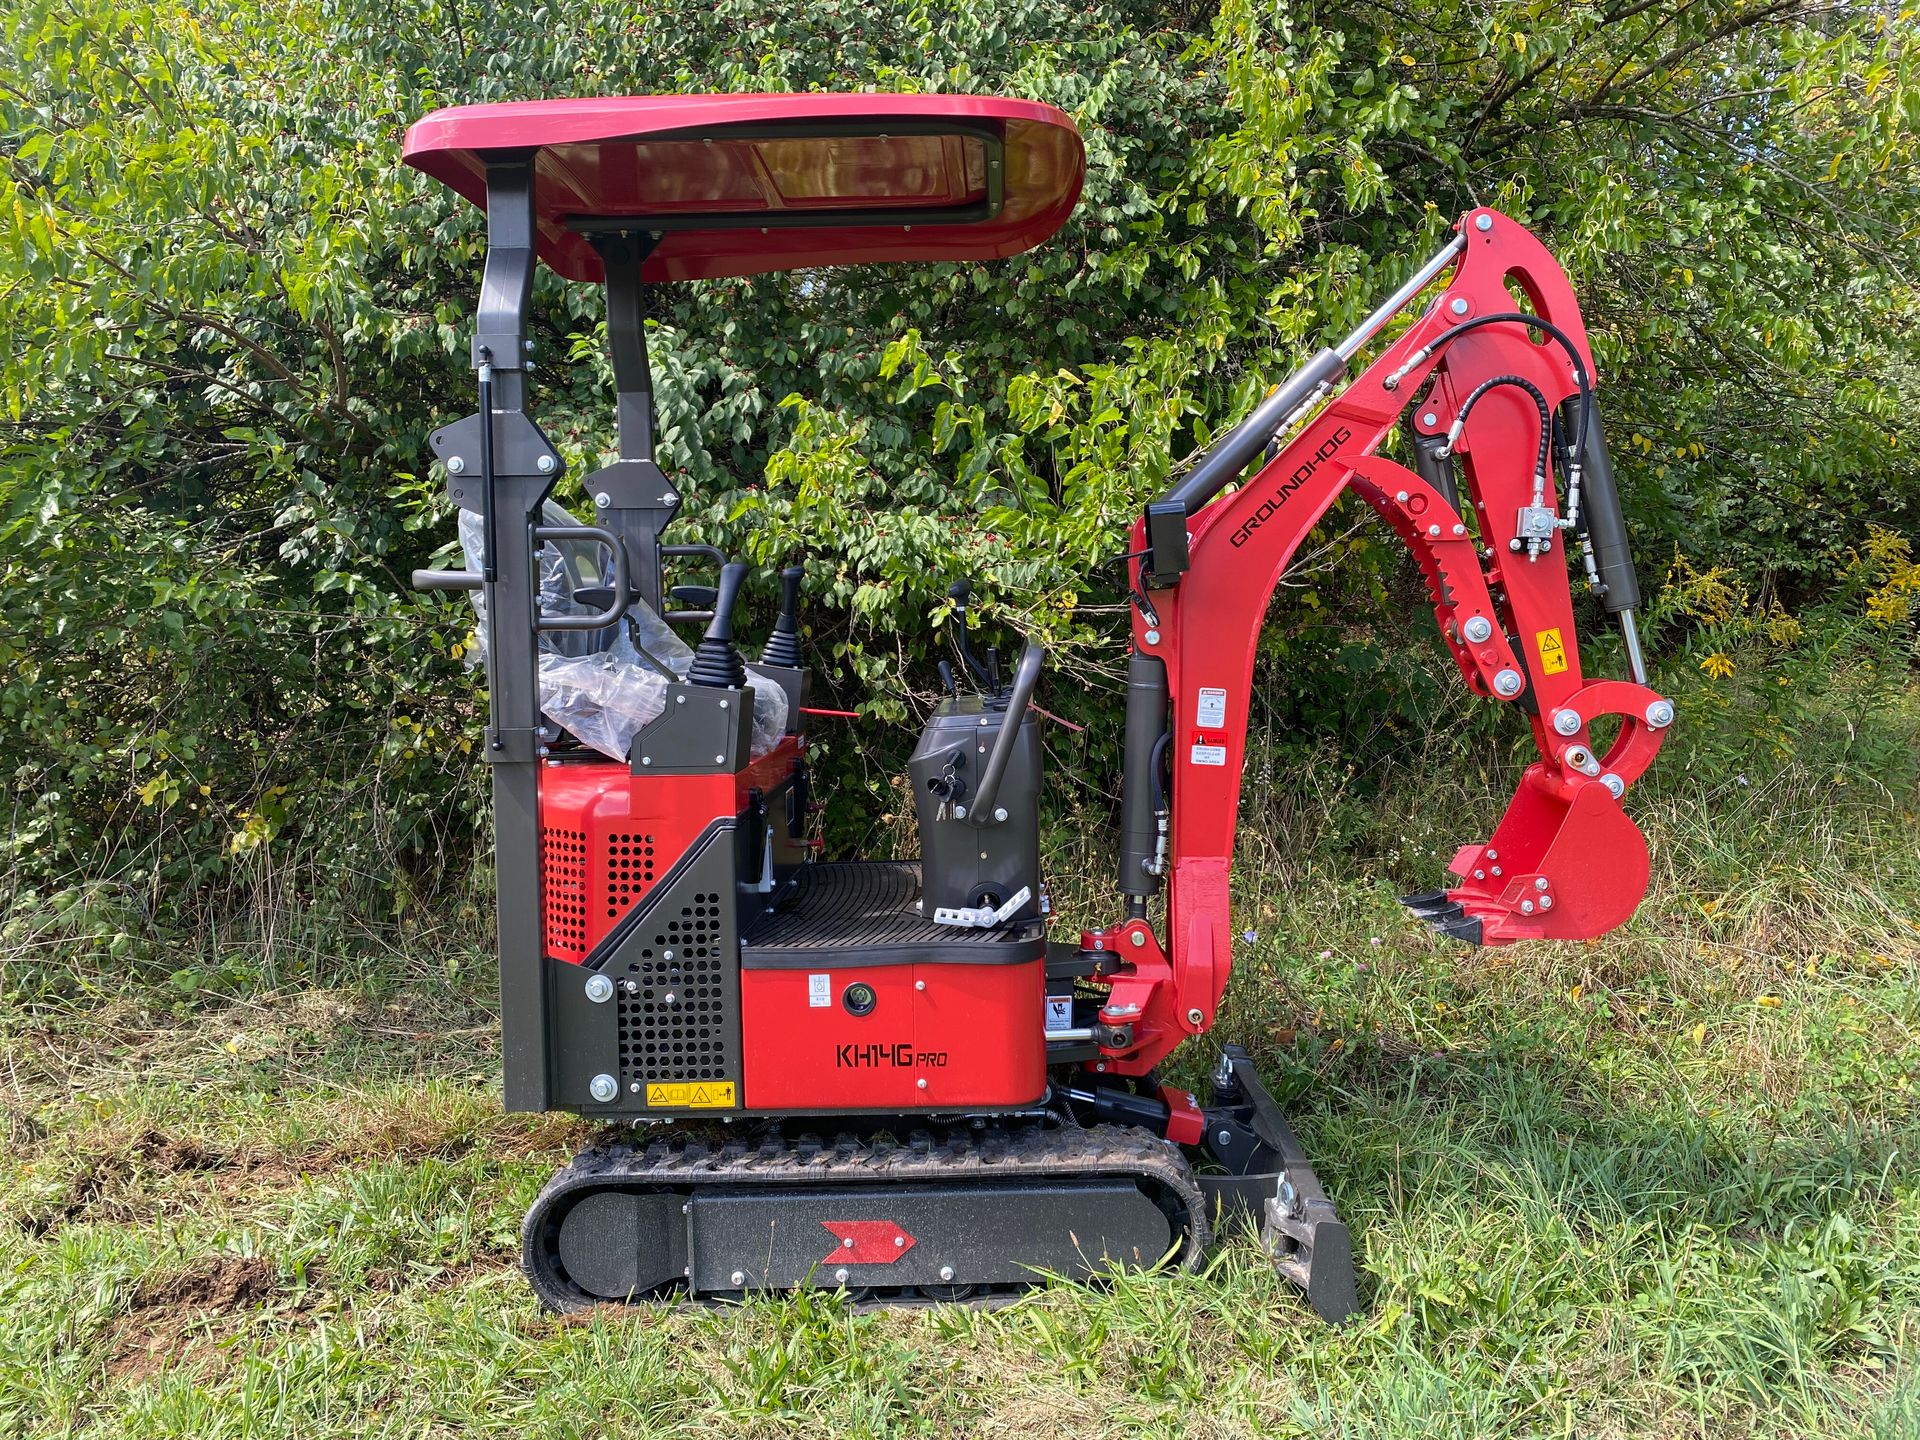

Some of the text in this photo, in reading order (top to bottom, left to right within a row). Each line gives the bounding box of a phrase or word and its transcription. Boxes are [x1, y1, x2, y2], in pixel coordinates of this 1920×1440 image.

[1230, 426, 1351, 548] GROUNDHOG
[836, 1044, 948, 1068] KH14G PRO
